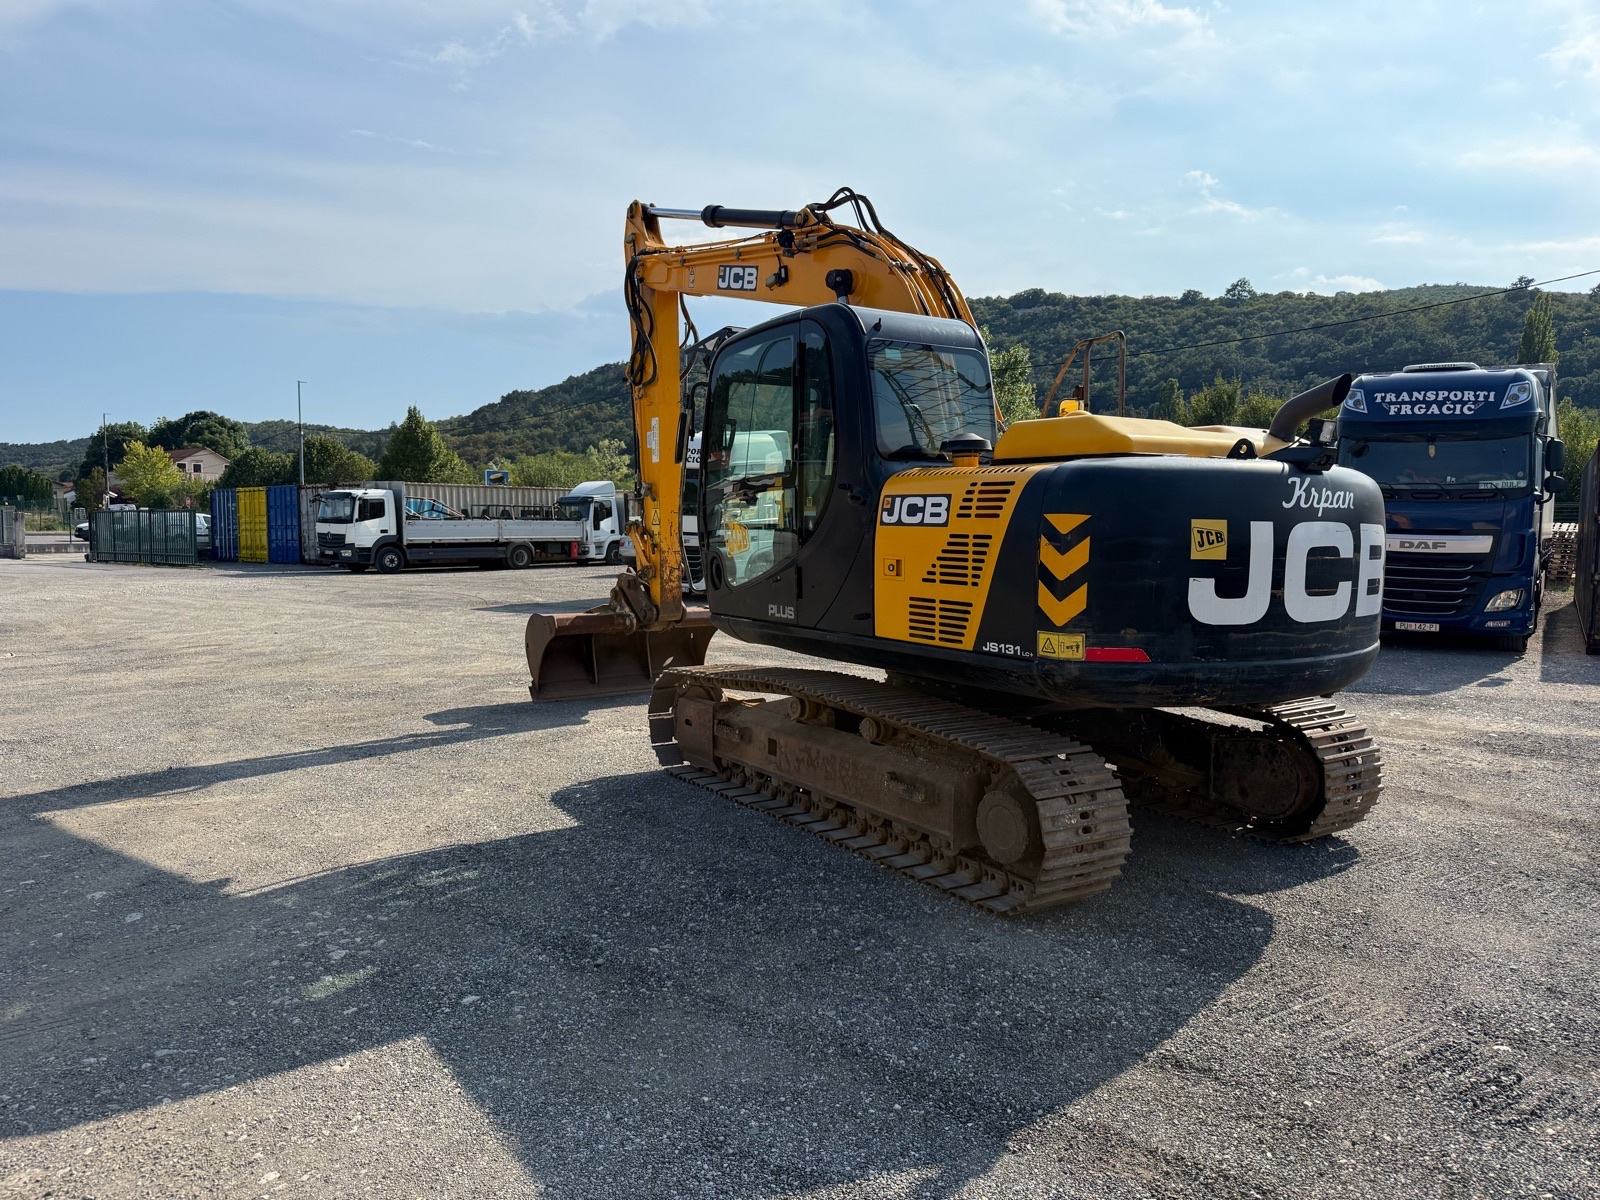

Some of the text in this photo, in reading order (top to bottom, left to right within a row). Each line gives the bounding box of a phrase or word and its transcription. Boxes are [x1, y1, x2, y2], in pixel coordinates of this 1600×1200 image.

[718, 266, 758, 290] JCB
[1374, 390, 1496, 403] TRANSPORTI
[1388, 401, 1475, 415] FRGAČIĆ
[1282, 477, 1354, 517] Krpan
[882, 496, 949, 524] JCB
[1197, 529, 1224, 548] JCB
[1399, 540, 1447, 550] DAF
[1187, 520, 1386, 625] JCB
[768, 604, 795, 619] PLUS
[982, 642, 1021, 655] JS131
